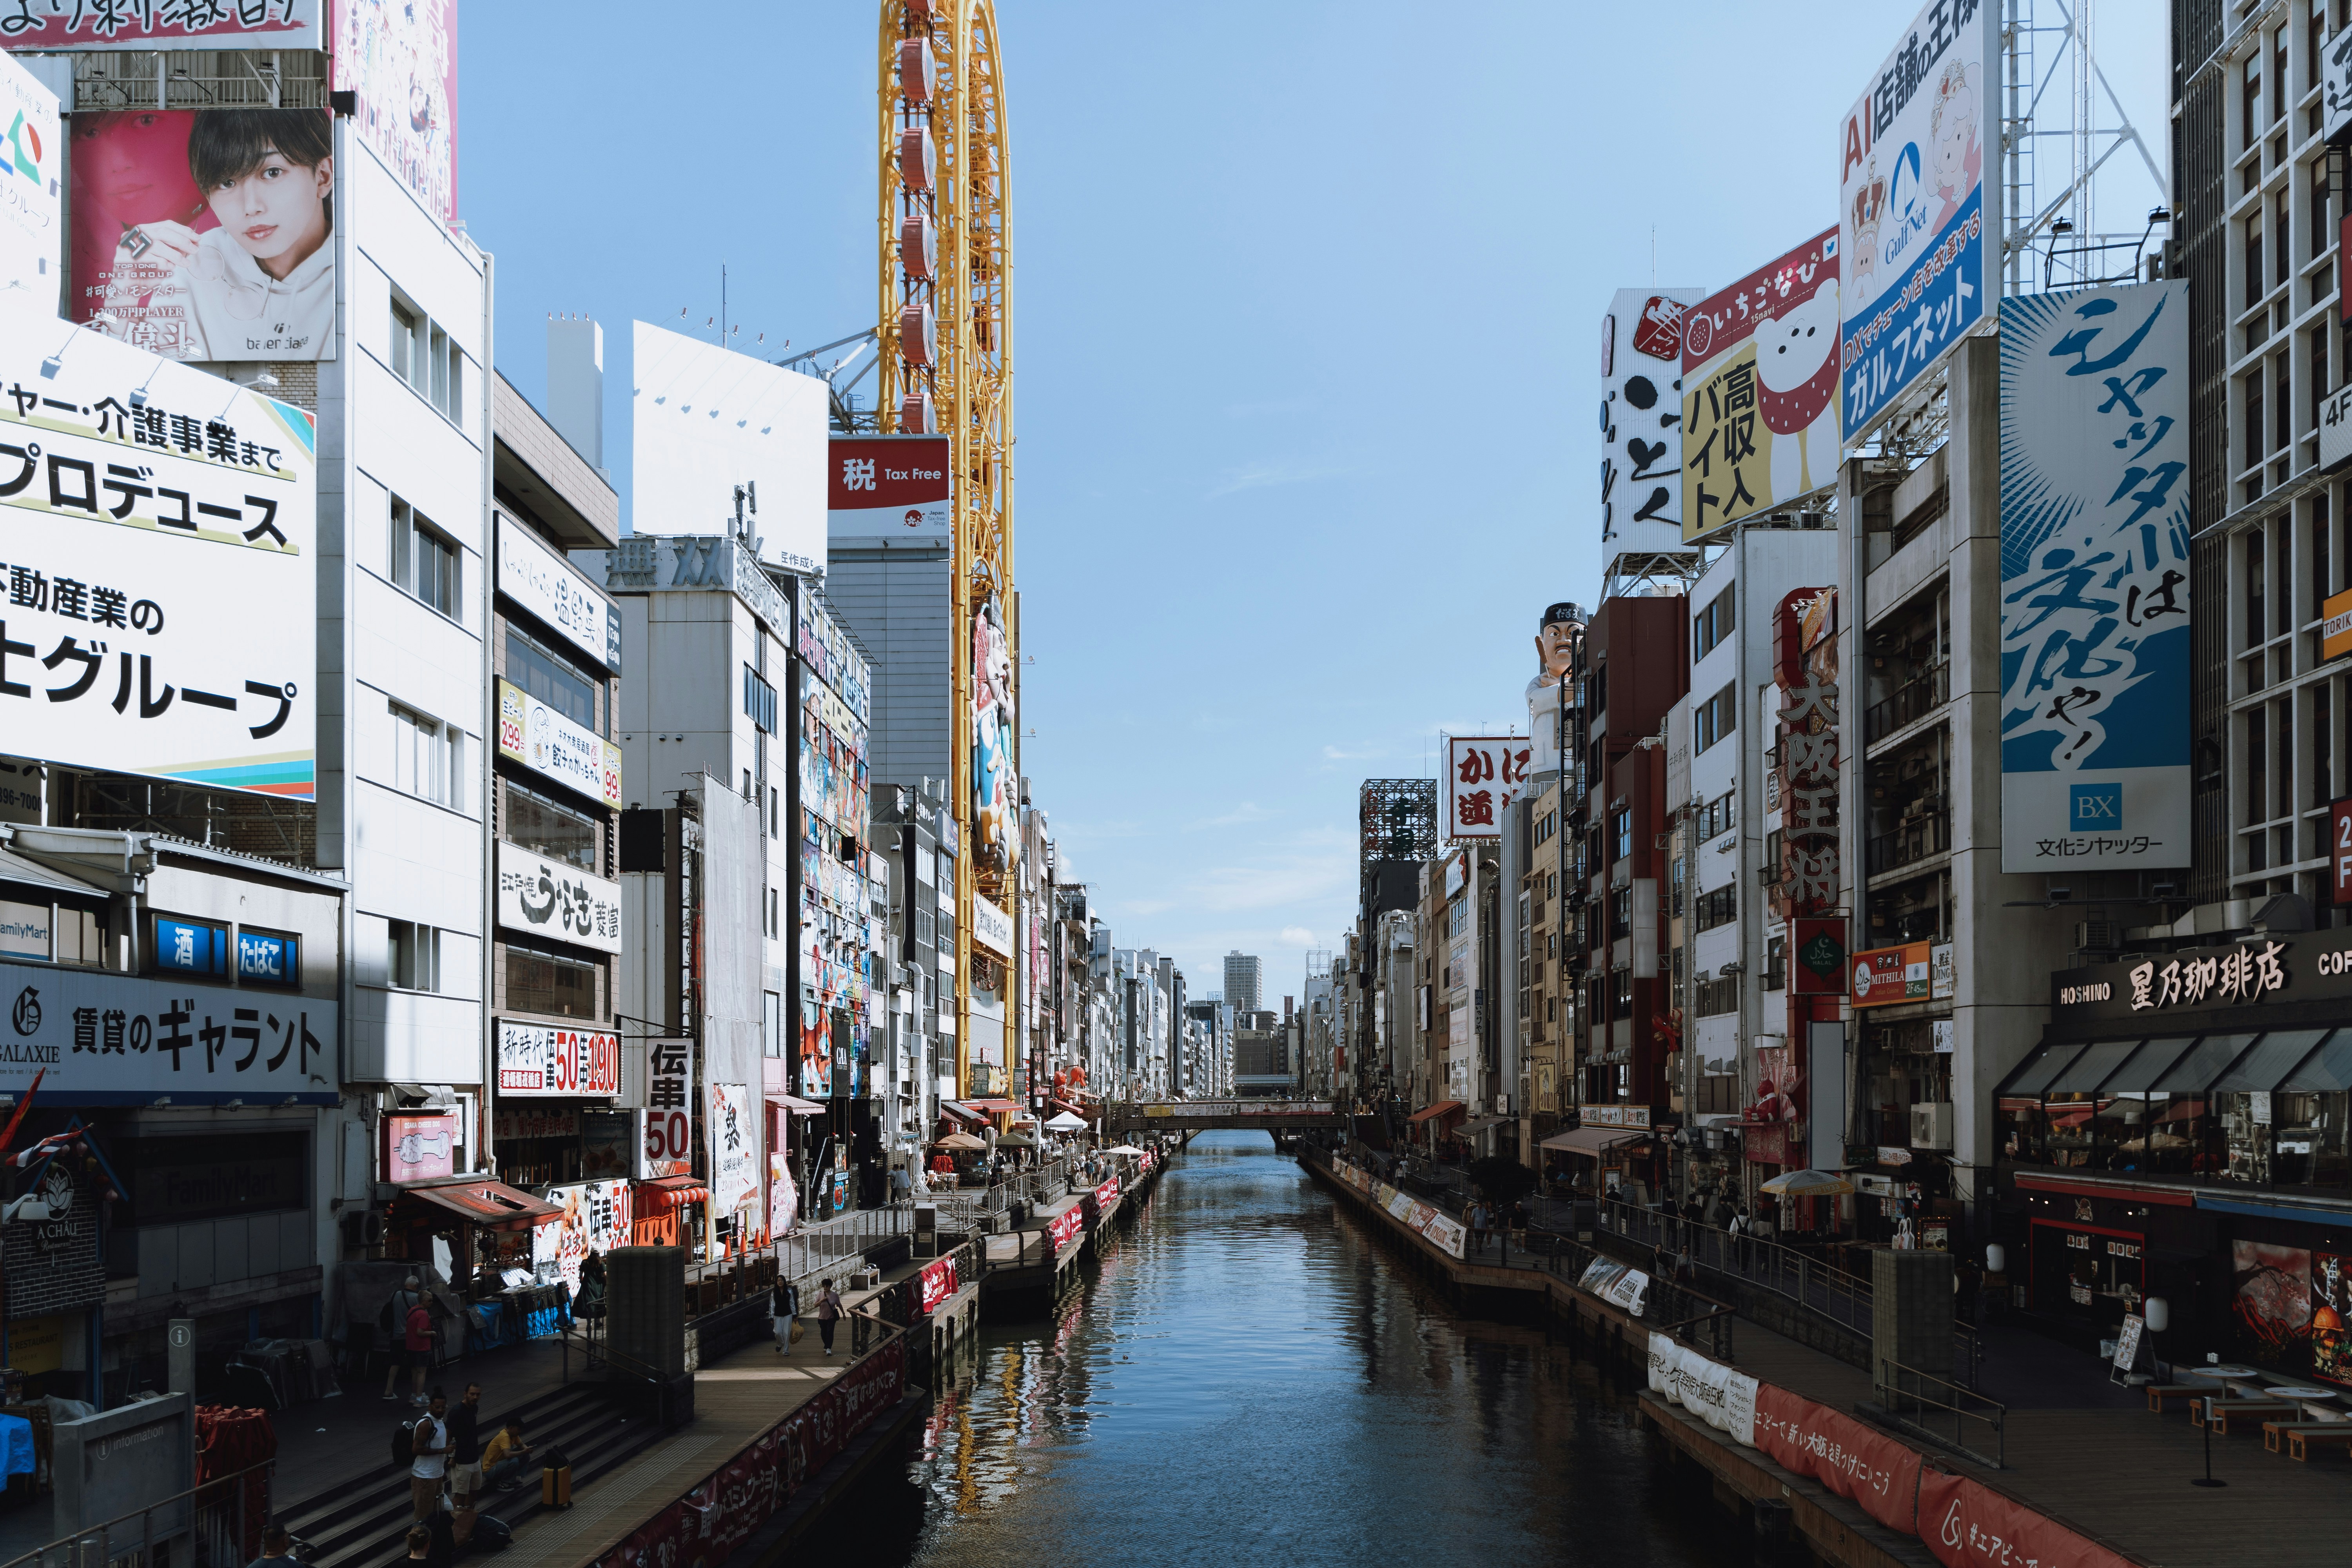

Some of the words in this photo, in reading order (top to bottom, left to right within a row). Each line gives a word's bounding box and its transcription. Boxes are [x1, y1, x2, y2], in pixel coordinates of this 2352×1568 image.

[85, 284, 187, 298] #可愛いモンスター
[1713, 252, 1819, 331] いちごなび
[1844, 207, 1981, 373] DXでチェーン店を改革する
[1750, 304, 1776, 325] 15navi
[1849, 265, 1974, 425] ガルフネット
[0, 380, 282, 473] ャー・介護事業まで
[1722, 358, 1757, 518] 高収入
[1688, 375, 1722, 530] バイト
[843, 458, 876, 491] 税
[885, 468, 908, 480] Tax
[913, 468, 942, 480] Free
[0, 442, 288, 549] プロデュース
[608, 626, 619, 645] 17:00
[503, 699, 523, 720] 生ビール
[502, 720, 520, 751] 299
[559, 728, 590, 756] ネオ大衆居酒屋
[552, 742, 600, 785] 餃子のかっちゃん
[604, 757, 621, 773] ハイボール
[1457, 747, 1530, 785] かに
[606, 770, 618, 800] 99
[1777, 671, 1840, 905] 大阪王将
[2076, 795, 2116, 818] BX
[520, 864, 593, 937] うなぎ
[174, 926, 194, 966] 酒
[240, 938, 280, 976] たばこ
[1809, 946, 1834, 960] حلال
[1871, 971, 1905, 985] MITHILA
[1932, 964, 1950, 981] DING
[2129, 940, 2287, 1011] 星乃珈琲店
[1475, 990, 1483, 1005] 焼肉
[1906, 983, 1914, 994] 2F
[2060, 982, 2111, 1005] HOSHINO
[72, 998, 321, 1076] 賃貸のギャラント
[504, 1026, 544, 1067] 新時代
[546, 1031, 555, 1091] 伝串
[556, 1032, 578, 1091] 50
[579, 1034, 588, 1091] 生中
[588, 1035, 617, 1091] 190
[975, 1068, 988, 1080] 薬
[503, 1071, 541, 1088] 道頓堀戎橋店
[650, 1043, 688, 1110] 伝串
[1014, 1072, 1025, 1083] 薬
[646, 1111, 688, 1160] 50
[166, 1165, 277, 1207] FamilyMart
[1822, 1183, 1840, 1192] 1933
[590, 1196, 612, 1237] 伝串
[612, 1185, 629, 1232] 50
[41, 1239, 73, 1252] Restaurant
[1613, 1289, 1633, 1303] JOYSOUND
[16, 1332, 58, 1350] RESTAURANT
[20, 1352, 38, 1363] DRINK
[113, 1422, 164, 1451] information
[735, 1525, 748, 1538] Osaka
